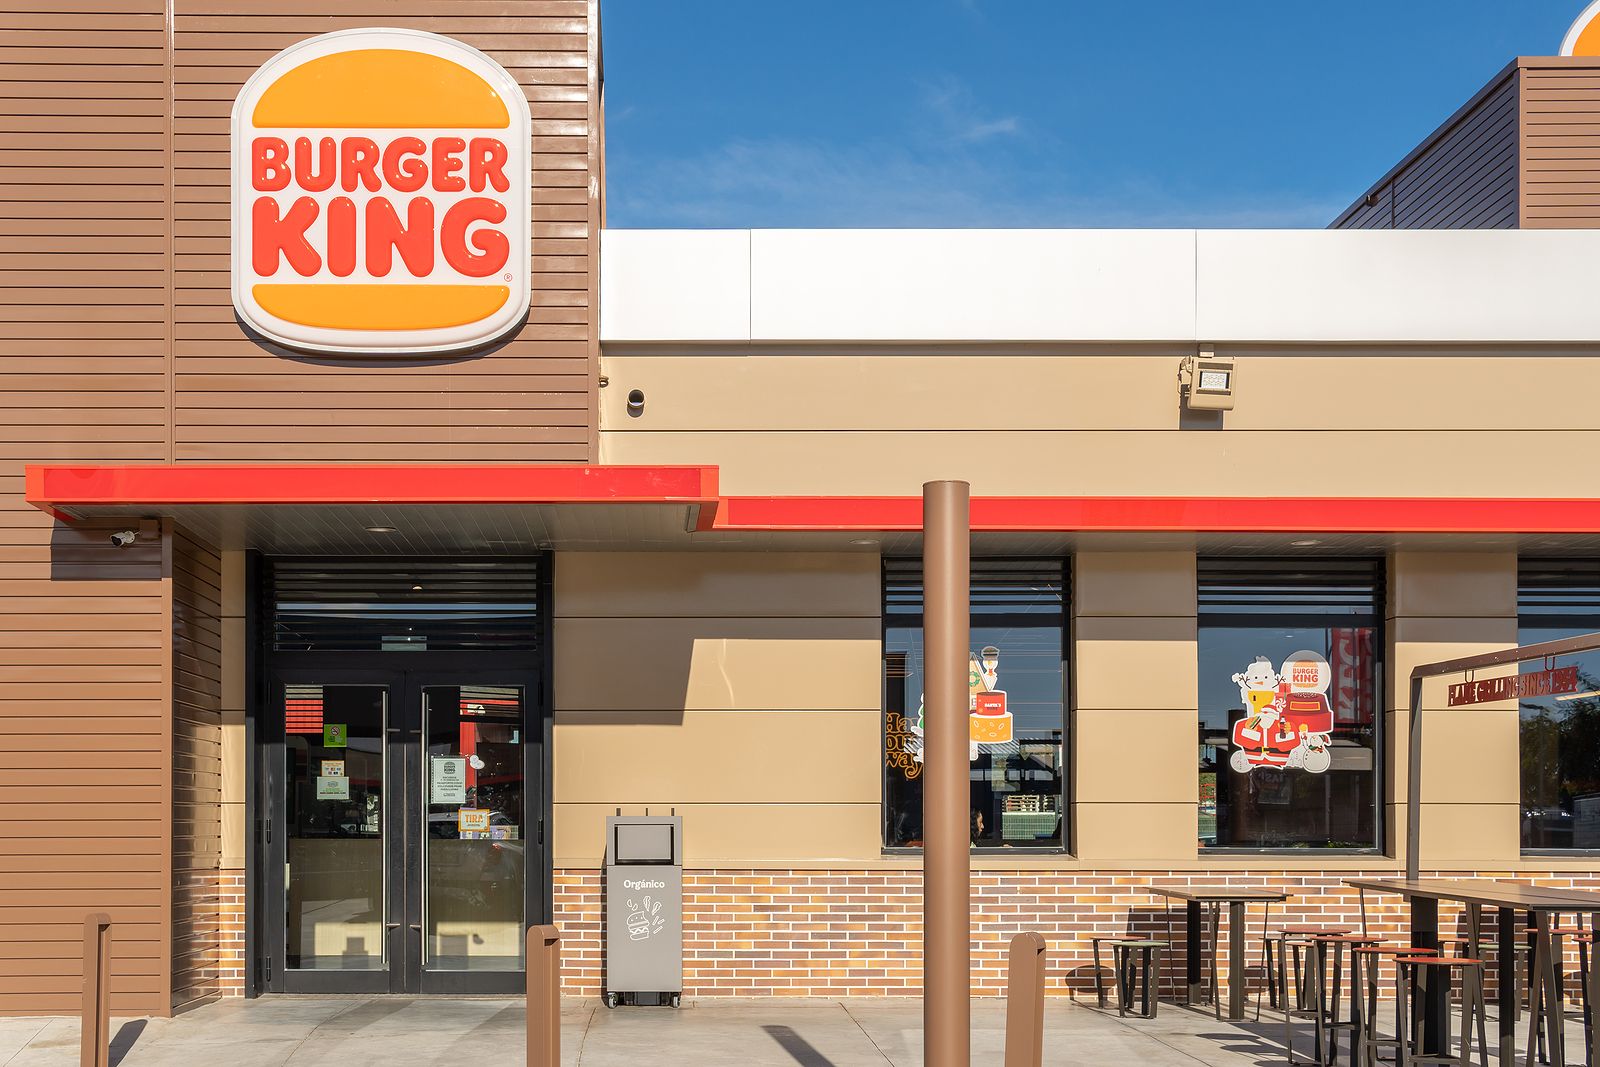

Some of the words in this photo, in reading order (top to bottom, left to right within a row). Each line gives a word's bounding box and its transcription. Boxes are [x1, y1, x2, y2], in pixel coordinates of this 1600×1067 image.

[252, 137, 510, 192] BURGER
[252, 196, 510, 278] KING
[1292, 674, 1319, 683] KING
[623, 879, 665, 890] Orgánico
